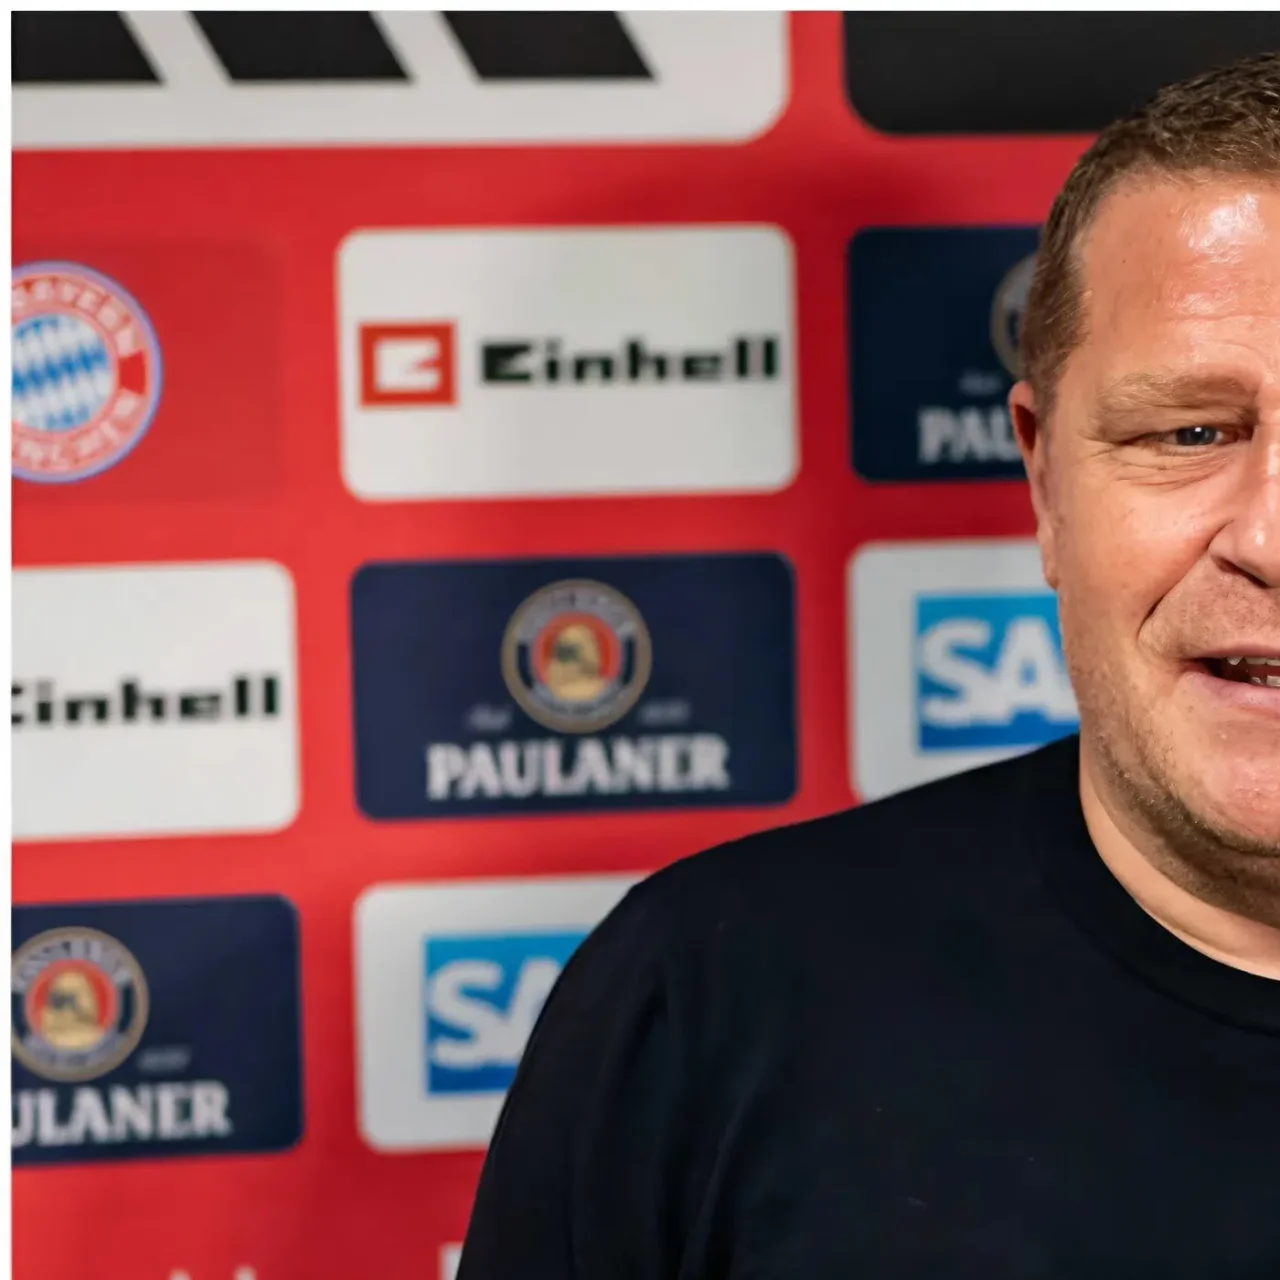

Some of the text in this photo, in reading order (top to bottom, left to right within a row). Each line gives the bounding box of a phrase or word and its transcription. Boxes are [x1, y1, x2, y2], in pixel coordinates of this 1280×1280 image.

[481, 336, 780, 384] Einhell
[11, 676, 278, 723] inhell
[427, 733, 730, 799] PAULANER
